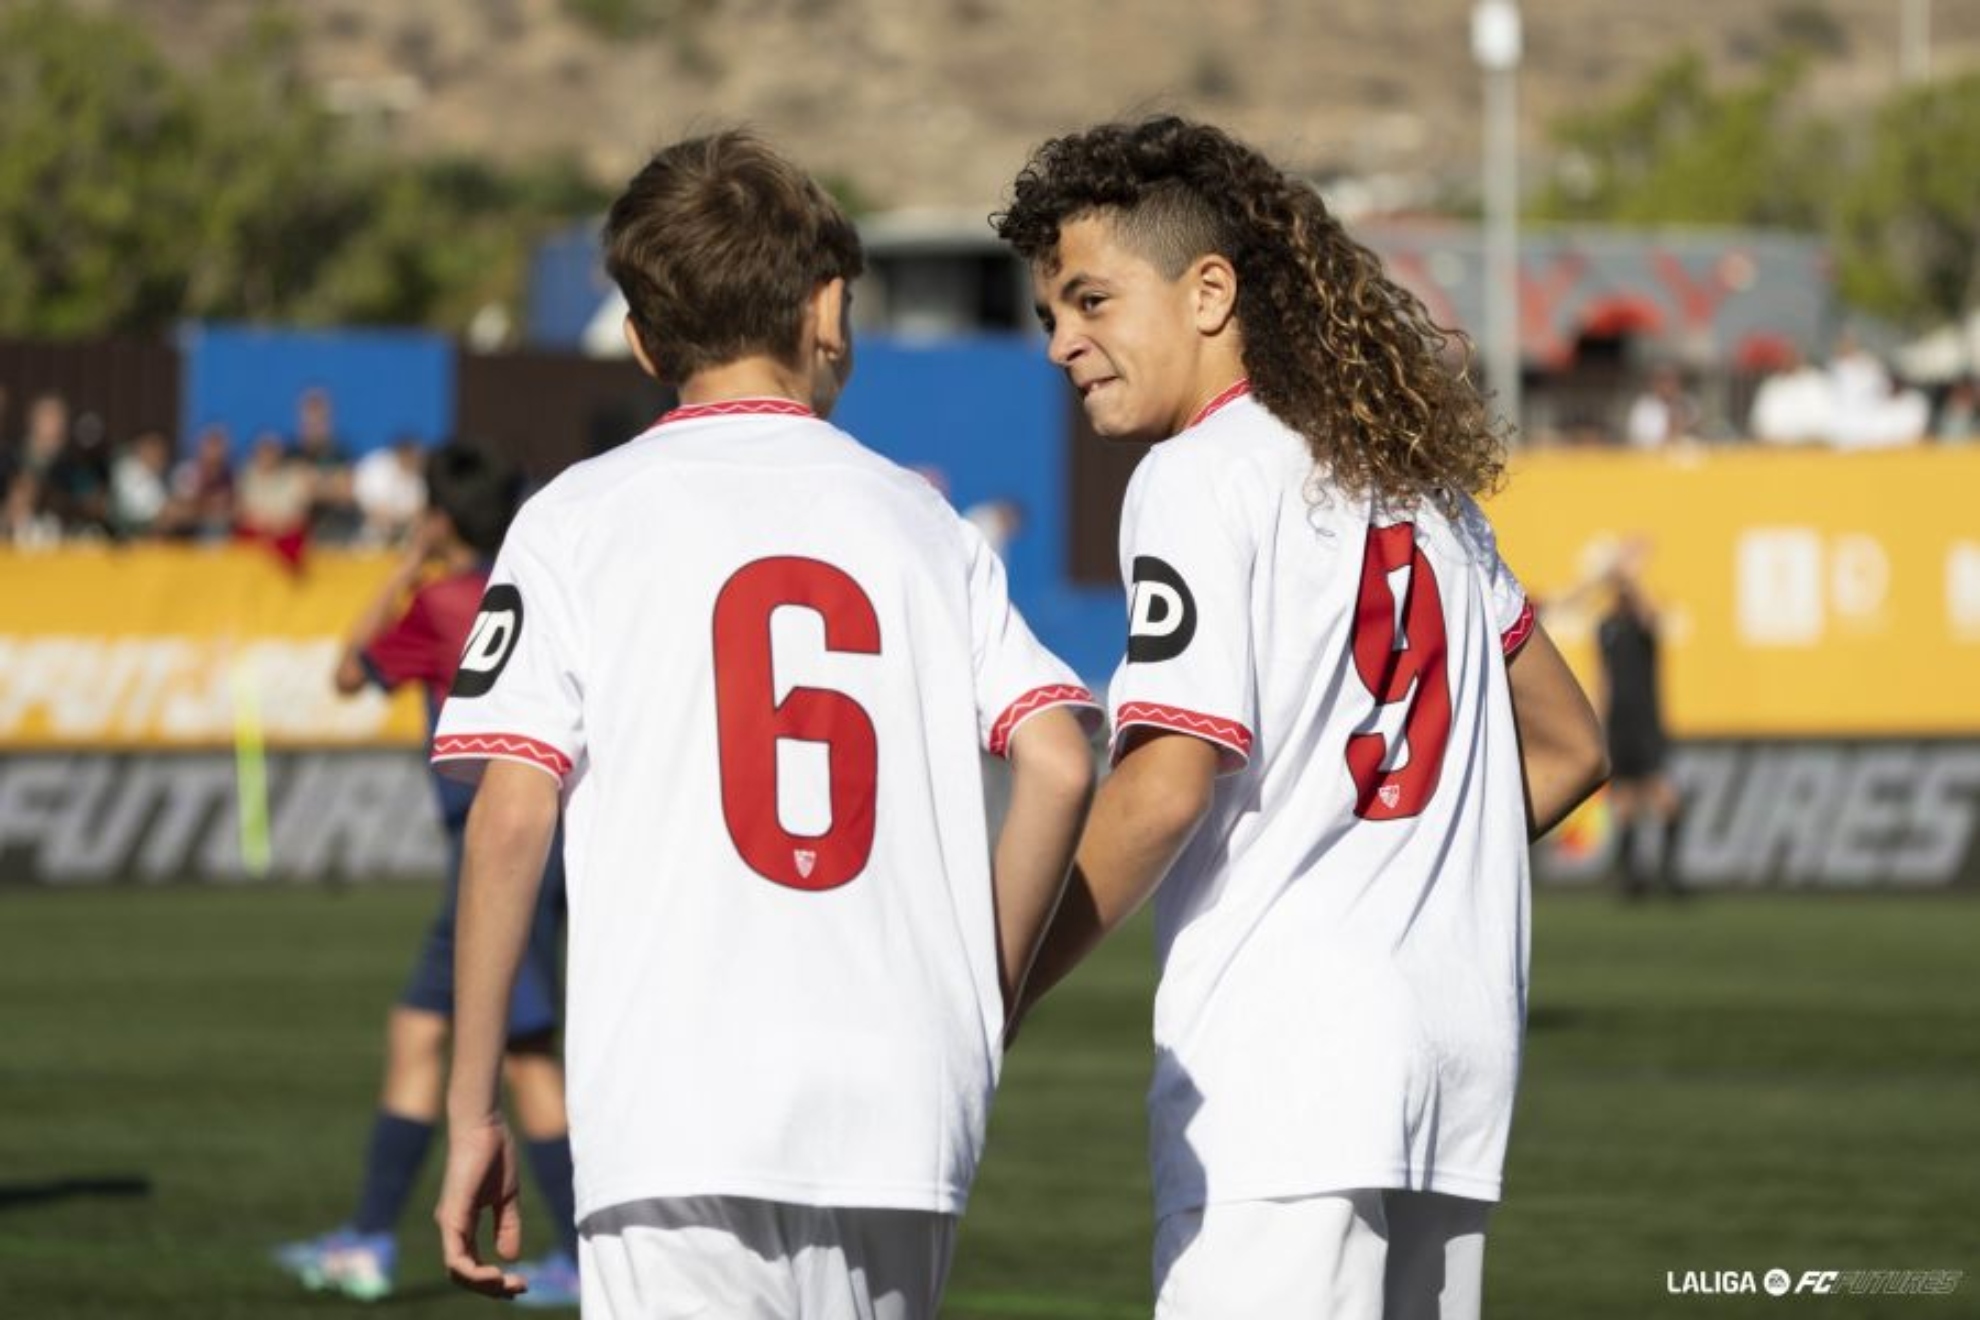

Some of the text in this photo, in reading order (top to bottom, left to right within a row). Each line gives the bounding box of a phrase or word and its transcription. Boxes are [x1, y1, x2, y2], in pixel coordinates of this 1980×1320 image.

[458, 610, 517, 673] D
[1129, 579, 1185, 637] D
[1345, 520, 1452, 821] 9
[711, 555, 882, 892] 6
[1645, 745, 1980, 886] TURES
